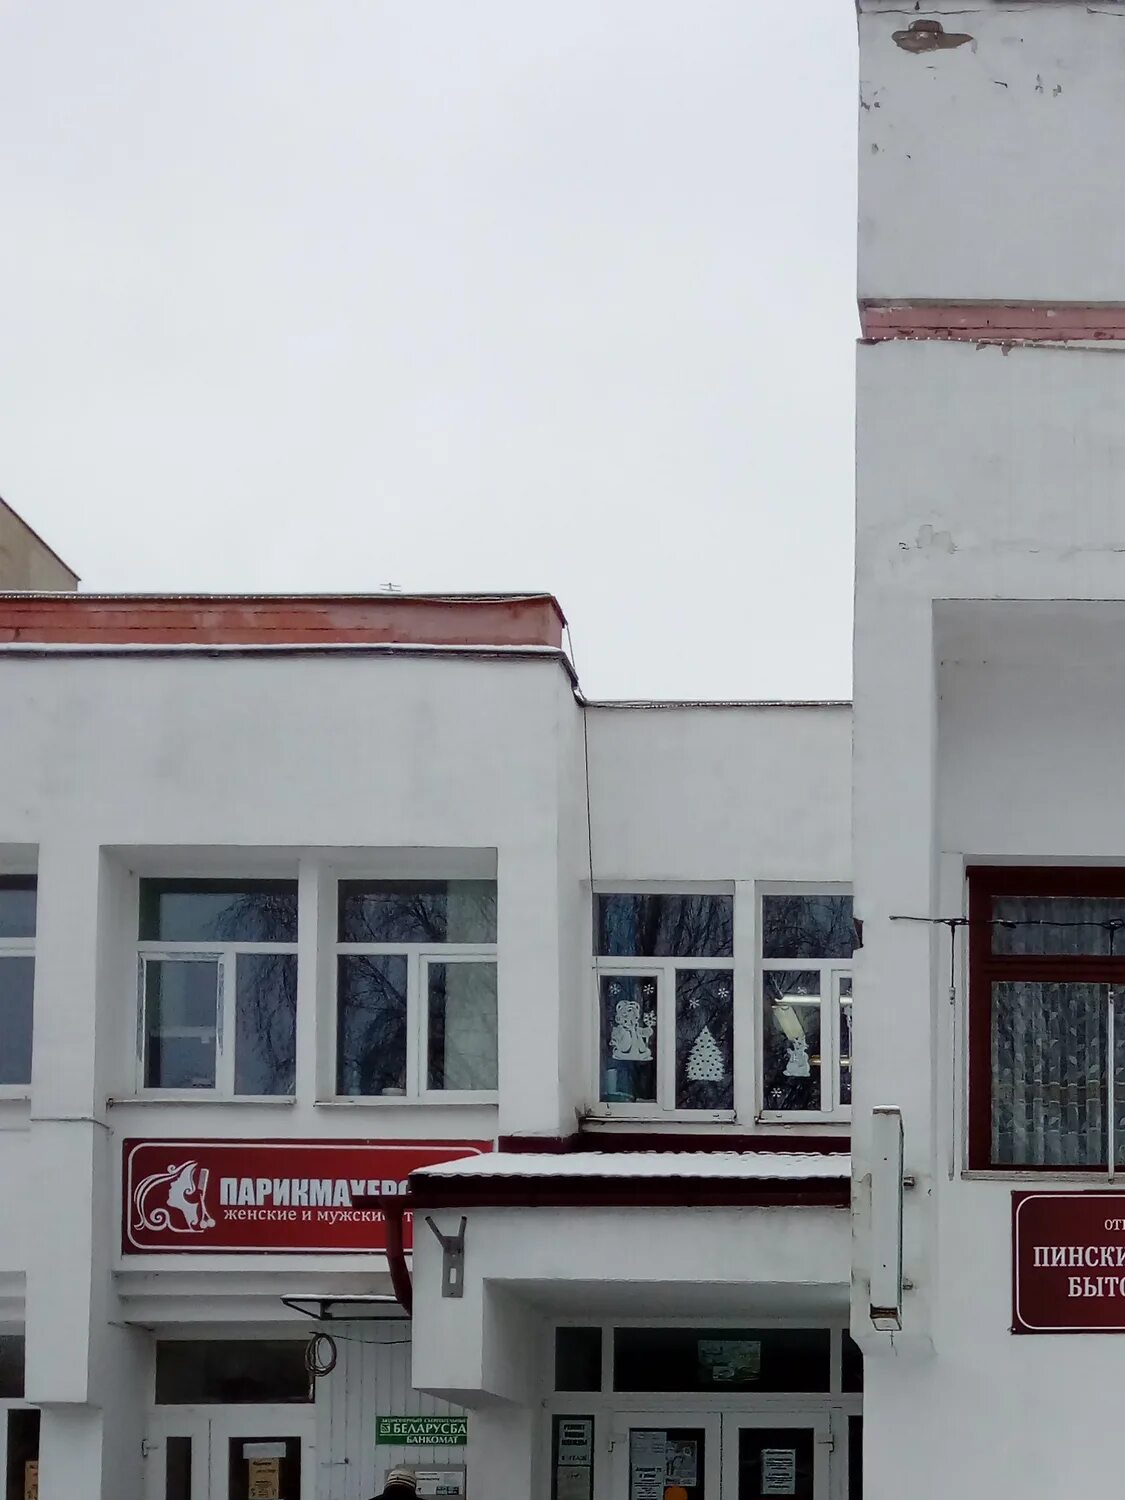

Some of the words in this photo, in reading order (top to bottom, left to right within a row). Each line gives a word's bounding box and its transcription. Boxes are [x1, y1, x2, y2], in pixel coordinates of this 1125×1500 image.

[224, 1208, 297, 1222] женские
[302, 1210, 312, 1221] и
[317, 1210, 386, 1225] мужски
[406, 1436, 458, 1444] БАНКОМАТ
